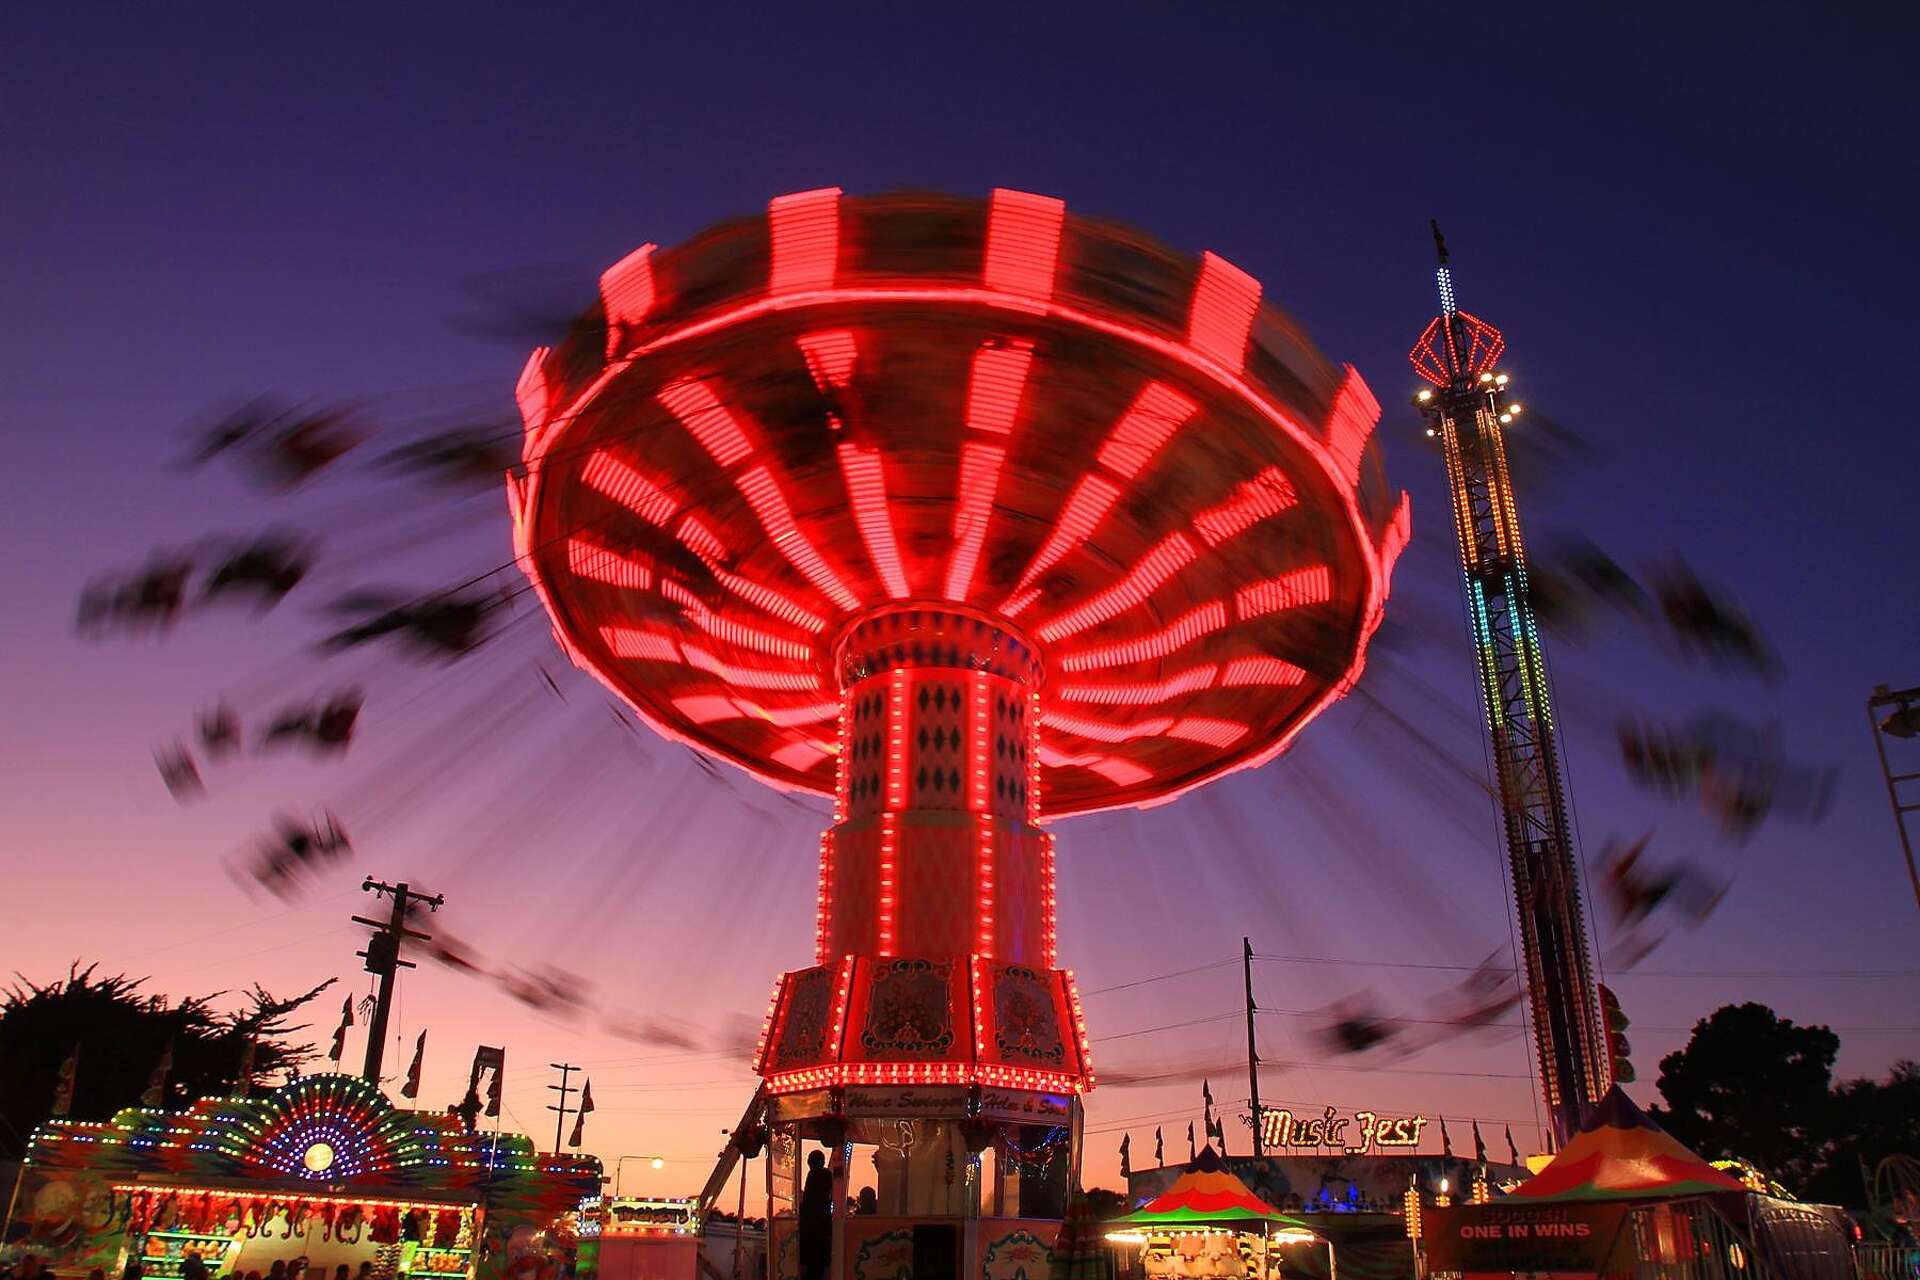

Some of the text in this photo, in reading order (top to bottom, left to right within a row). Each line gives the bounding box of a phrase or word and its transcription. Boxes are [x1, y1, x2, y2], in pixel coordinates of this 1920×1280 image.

[1262, 1106, 1428, 1155] Music Fest
[1459, 1223, 1591, 1239] ONE IN WINS
